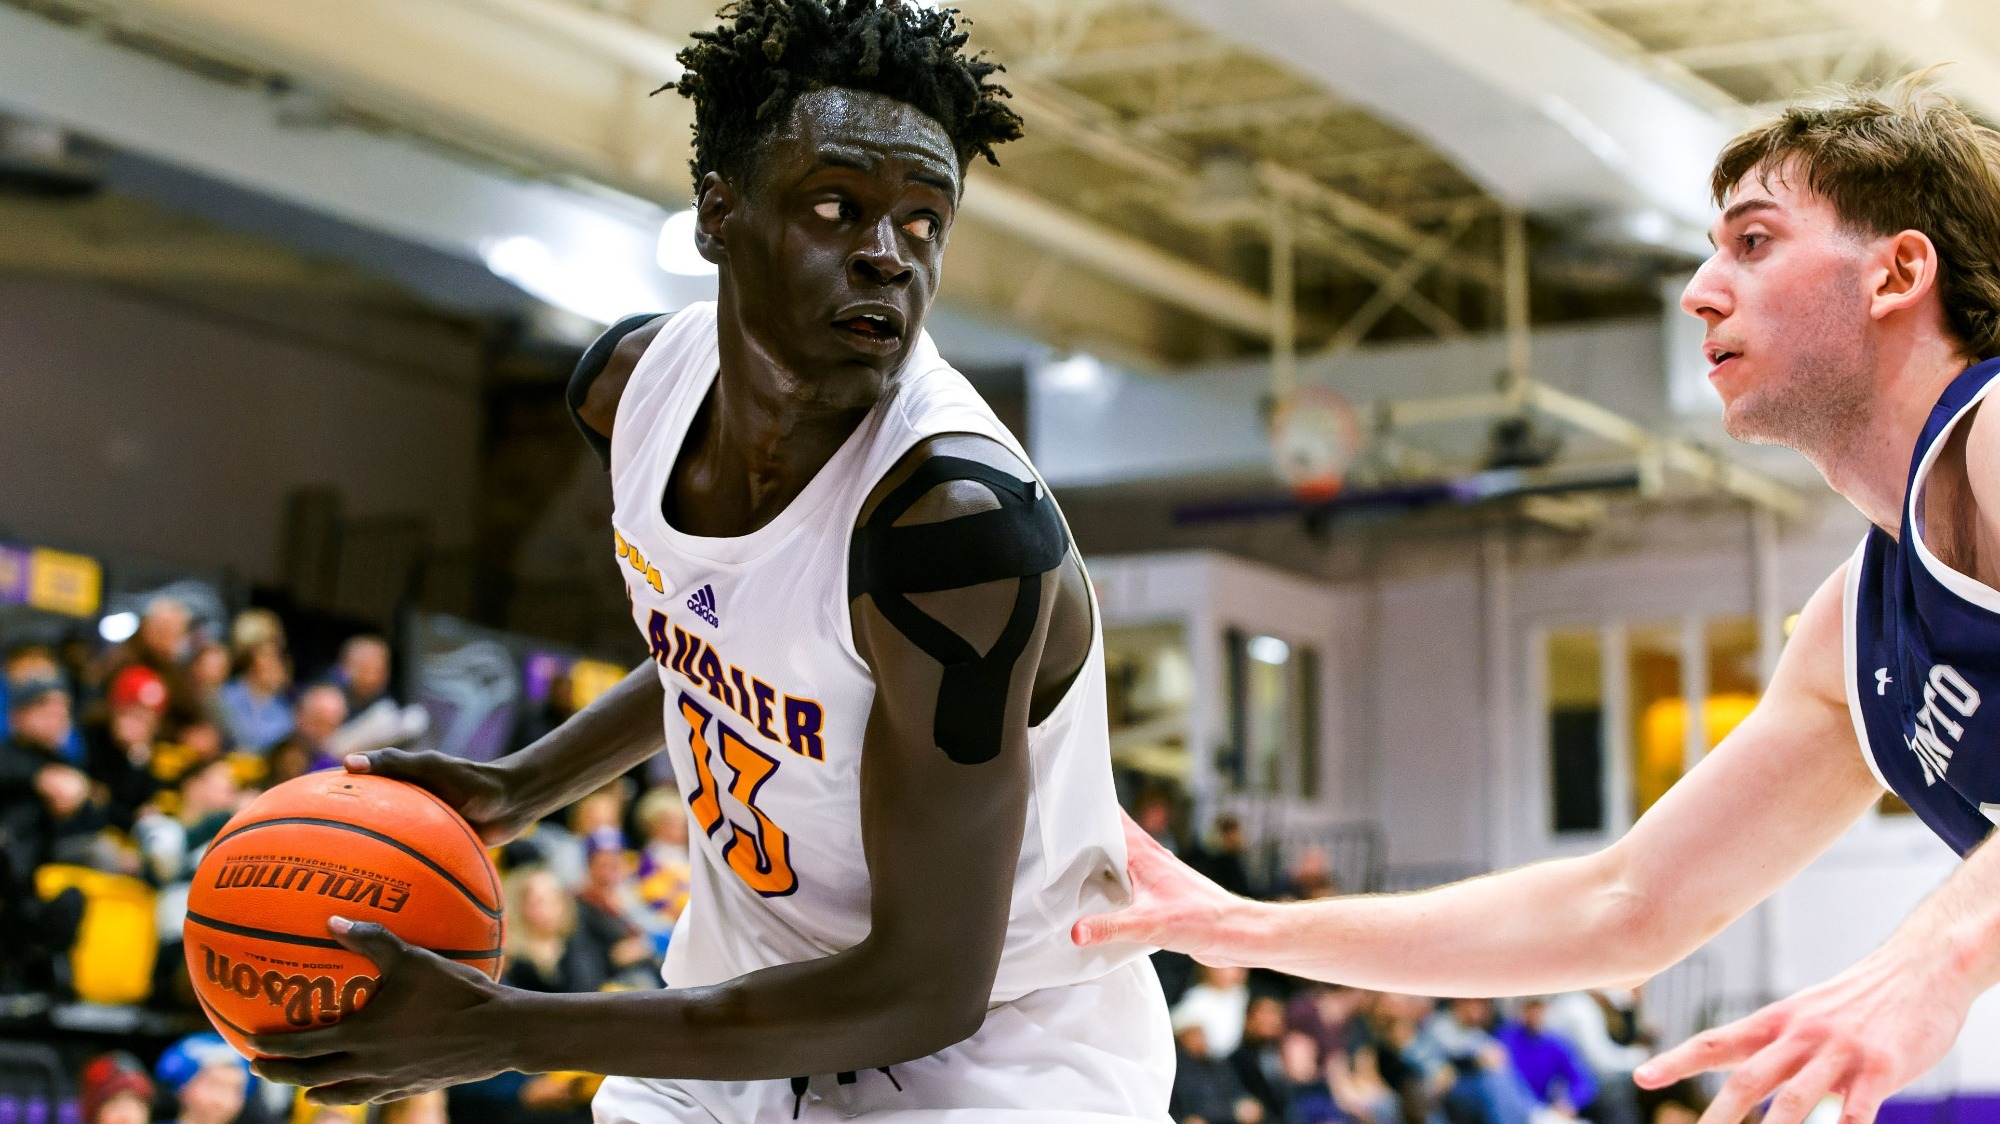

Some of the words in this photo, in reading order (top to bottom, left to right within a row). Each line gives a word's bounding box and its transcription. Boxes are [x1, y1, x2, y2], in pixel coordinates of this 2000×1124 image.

[627, 582, 826, 763] AURIER
[687, 599, 719, 629] adidas
[1903, 663, 1981, 787] NTO
[677, 690, 799, 898] 13
[214, 864, 411, 914] EVOLUTION
